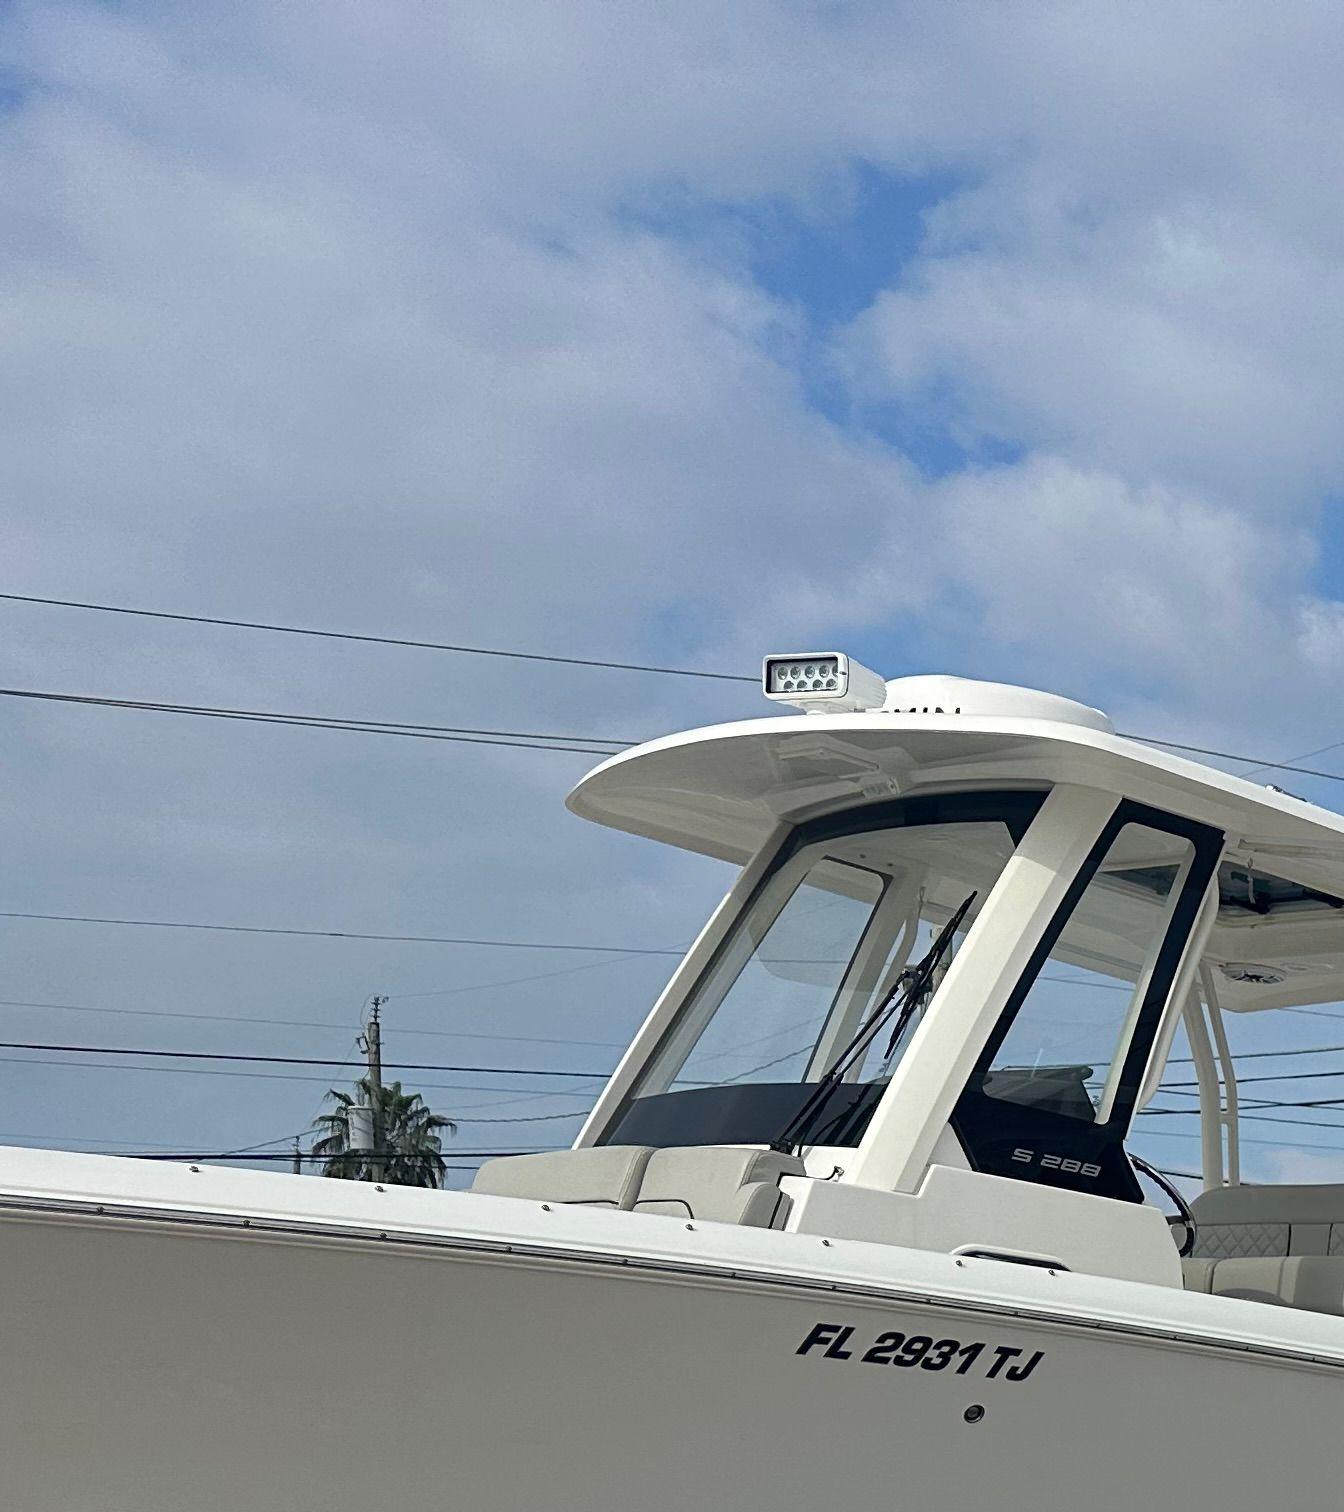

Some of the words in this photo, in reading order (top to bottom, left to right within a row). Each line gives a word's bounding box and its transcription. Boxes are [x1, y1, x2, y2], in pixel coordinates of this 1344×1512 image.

[1011, 1148, 1034, 1163] S
[1040, 1154, 1102, 1177] 288
[795, 1322, 856, 1361] FL
[860, 1331, 986, 1375] 2931
[985, 1346, 1046, 1382] TJ
